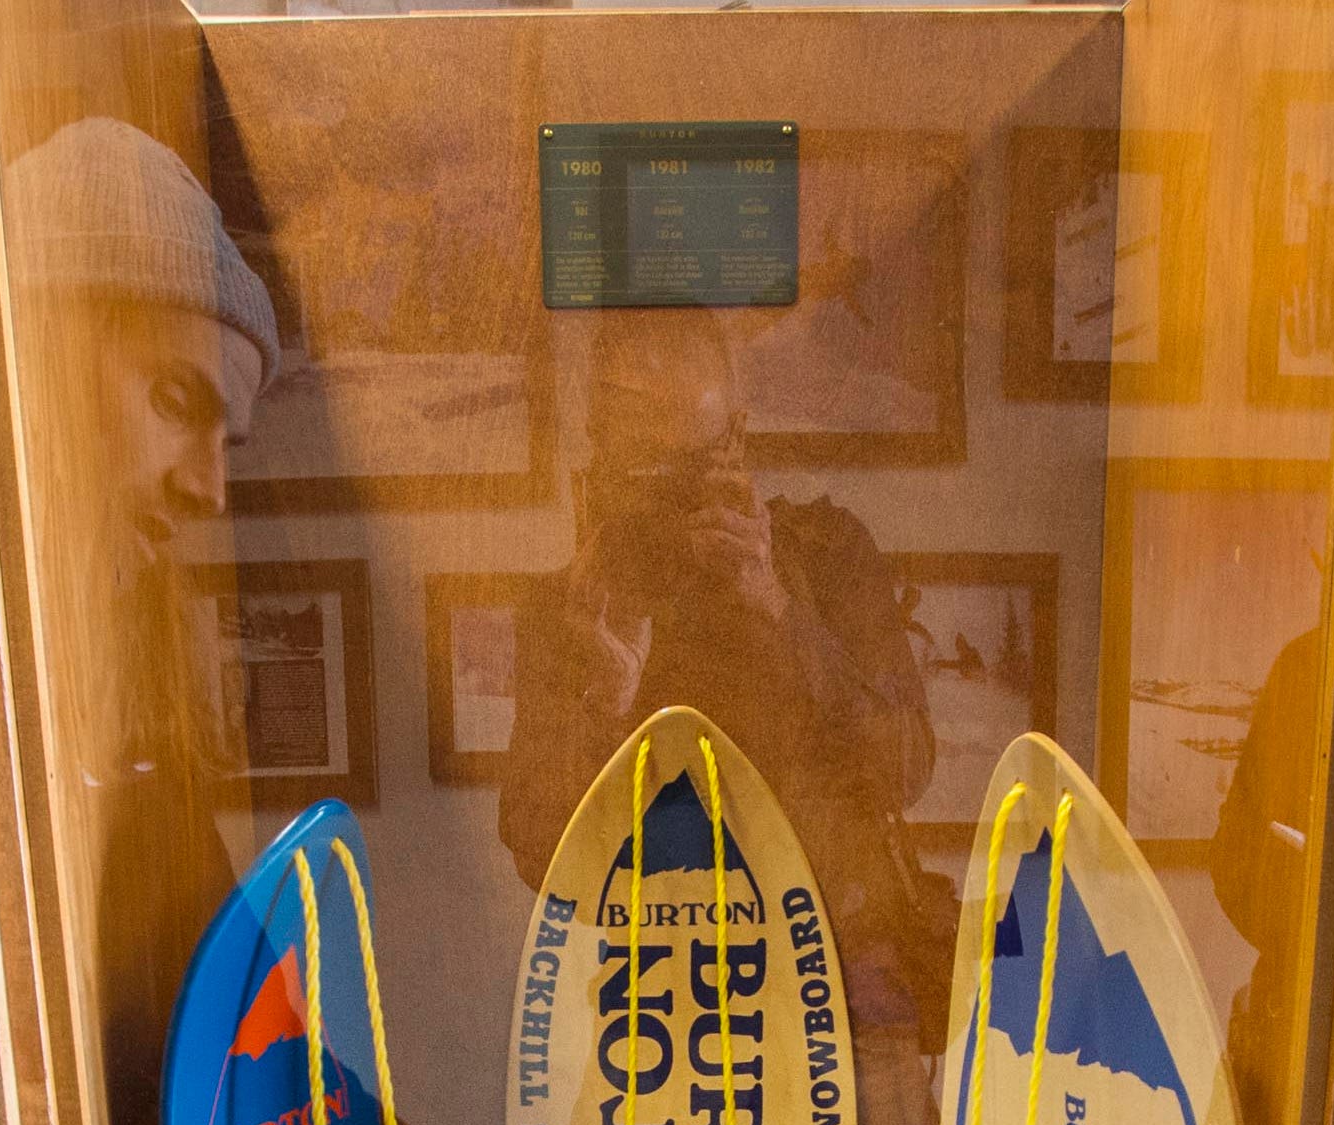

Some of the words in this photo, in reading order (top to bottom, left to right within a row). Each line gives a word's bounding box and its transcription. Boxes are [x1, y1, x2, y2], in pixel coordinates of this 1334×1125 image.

[561, 161, 603, 176] 1980
[649, 160, 688, 176] 1981
[734, 159, 776, 175] 1982
[519, 893, 578, 1107] BACKHILL
